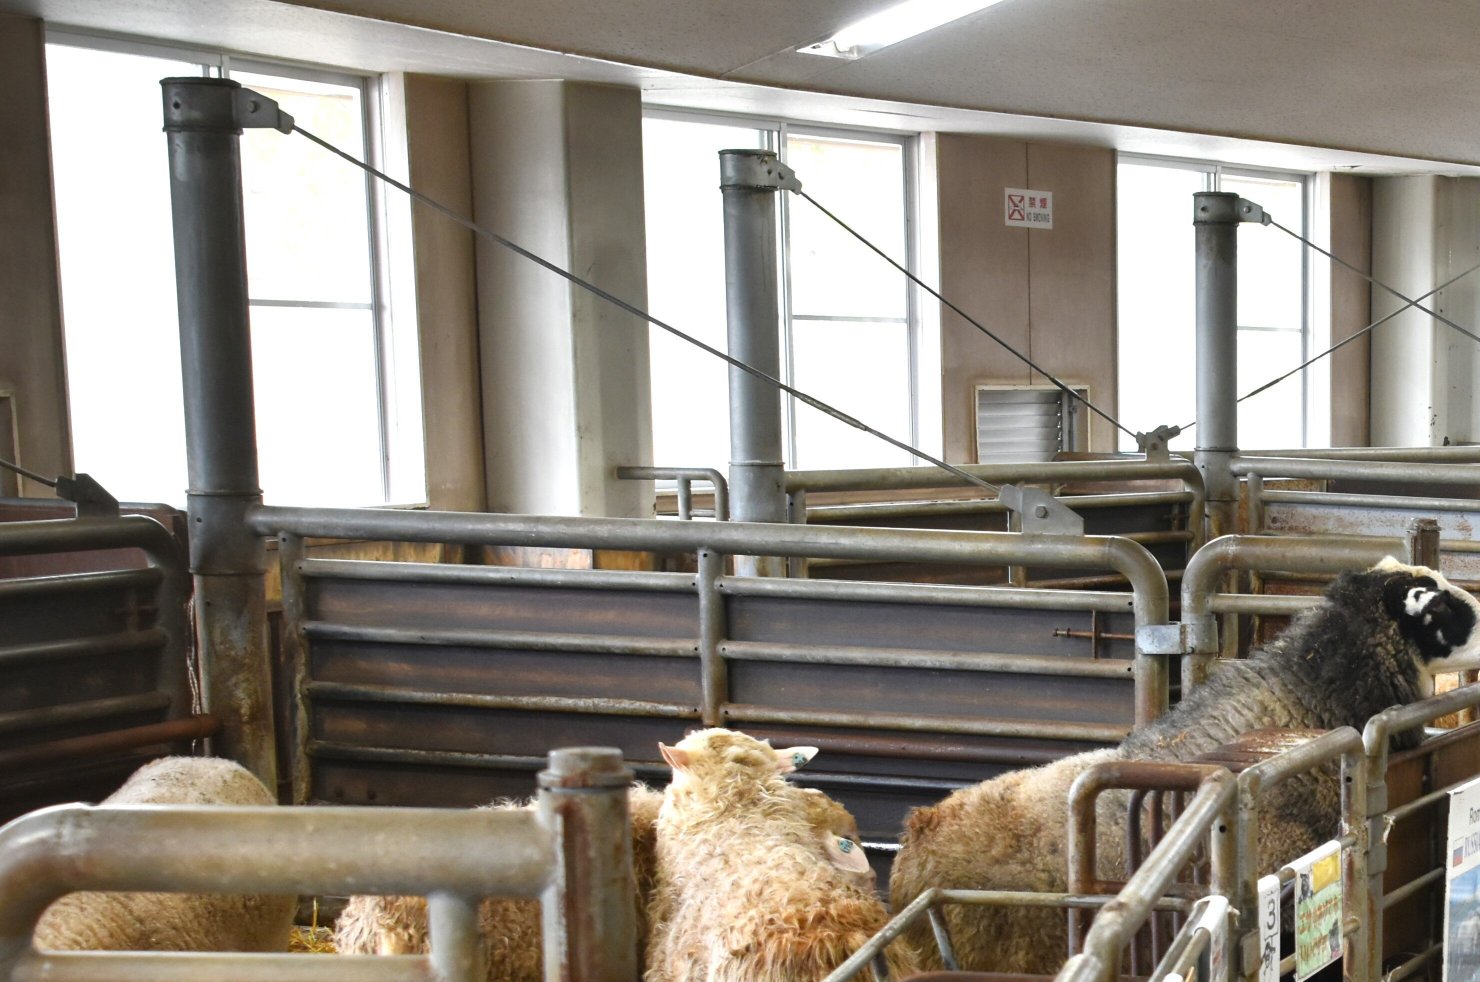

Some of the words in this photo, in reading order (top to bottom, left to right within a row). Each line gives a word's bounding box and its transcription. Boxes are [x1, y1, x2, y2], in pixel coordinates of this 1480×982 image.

[1029, 197, 1048, 209] 禁煙
[1464, 830, 1480, 857] RUSSIA
[1267, 898, 1276, 930] 3
